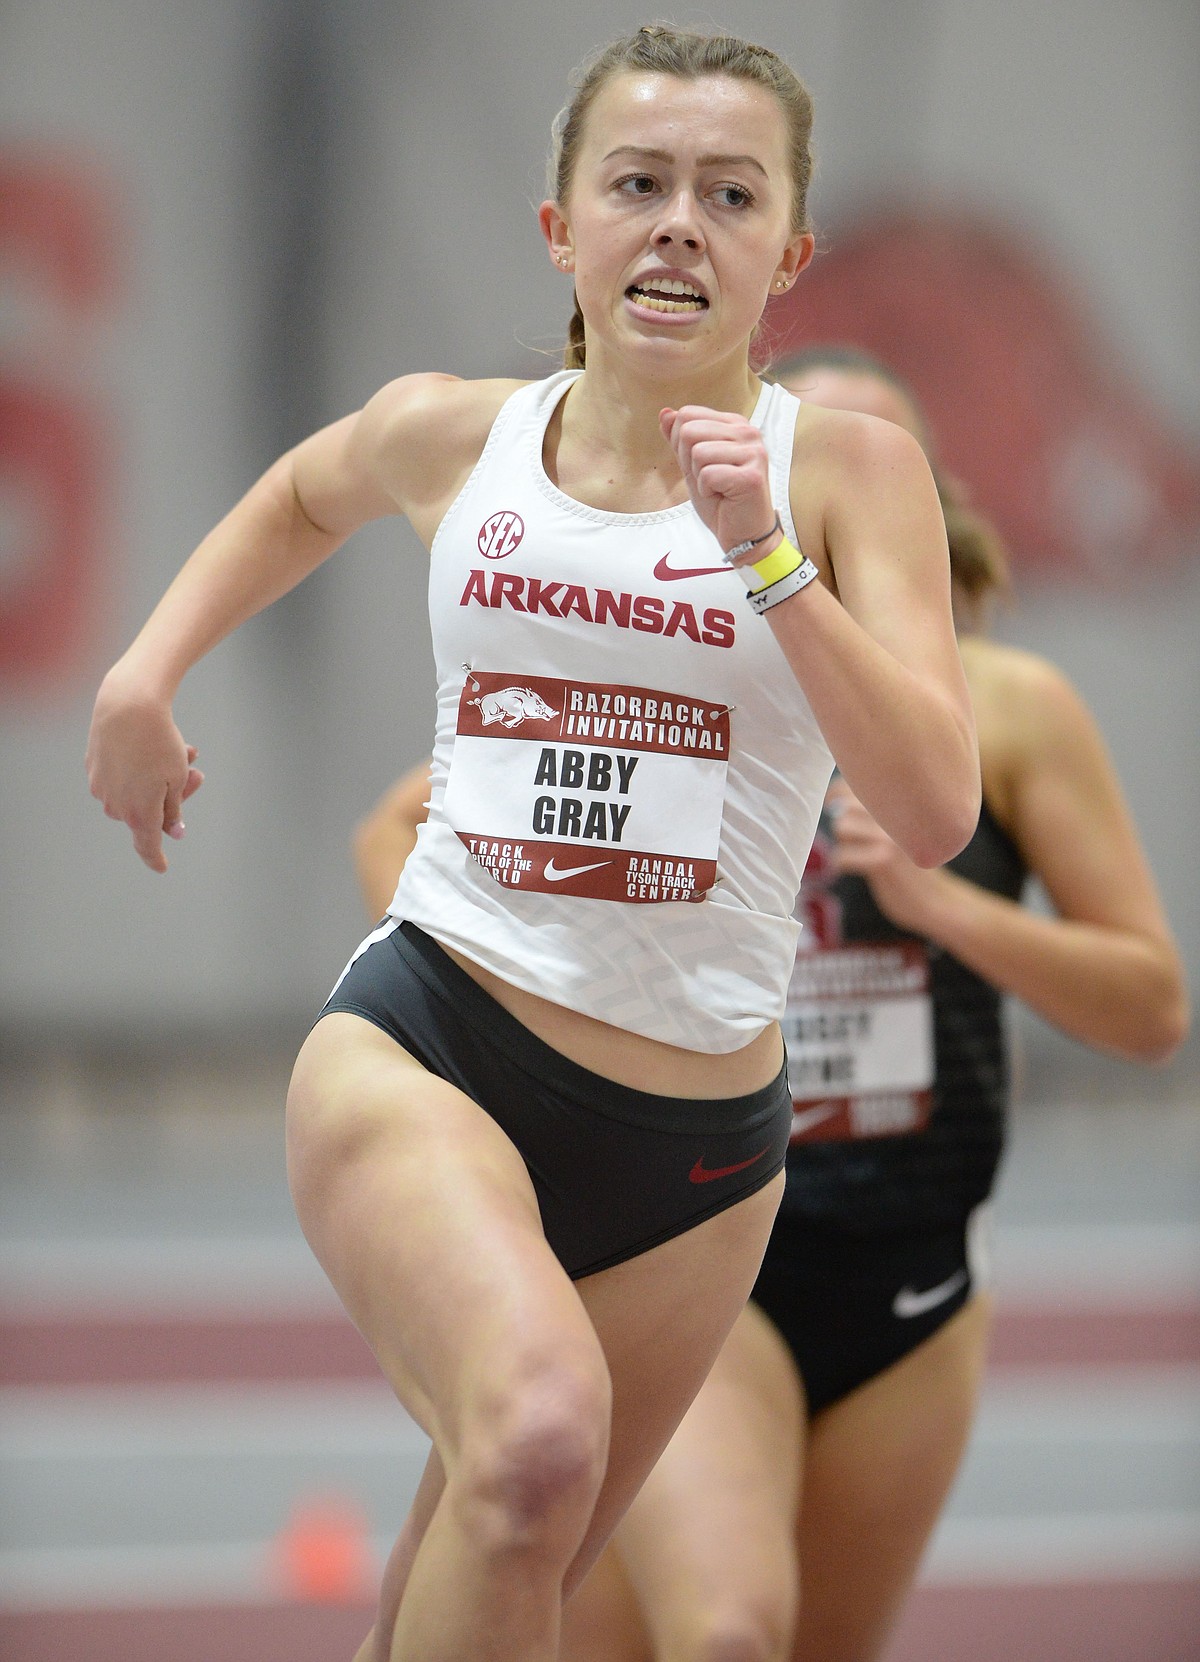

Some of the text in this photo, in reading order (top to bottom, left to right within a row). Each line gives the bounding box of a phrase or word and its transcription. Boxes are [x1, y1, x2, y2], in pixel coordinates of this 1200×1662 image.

[478, 511, 524, 558] SEC
[459, 569, 736, 649] ARKANSAS
[570, 690, 705, 726] RAZORBACK
[566, 714, 724, 751] INVITATIONAL
[534, 747, 639, 795] ABBY
[532, 795, 632, 843] GRAY
[469, 839, 524, 859] TRACK
[472, 854, 532, 871] PITAL OF THE
[483, 866, 521, 884] RLD
[626, 870, 696, 890] TYSON TRACK
[629, 857, 695, 878] RANDAL
[626, 883, 691, 900] CENTER
